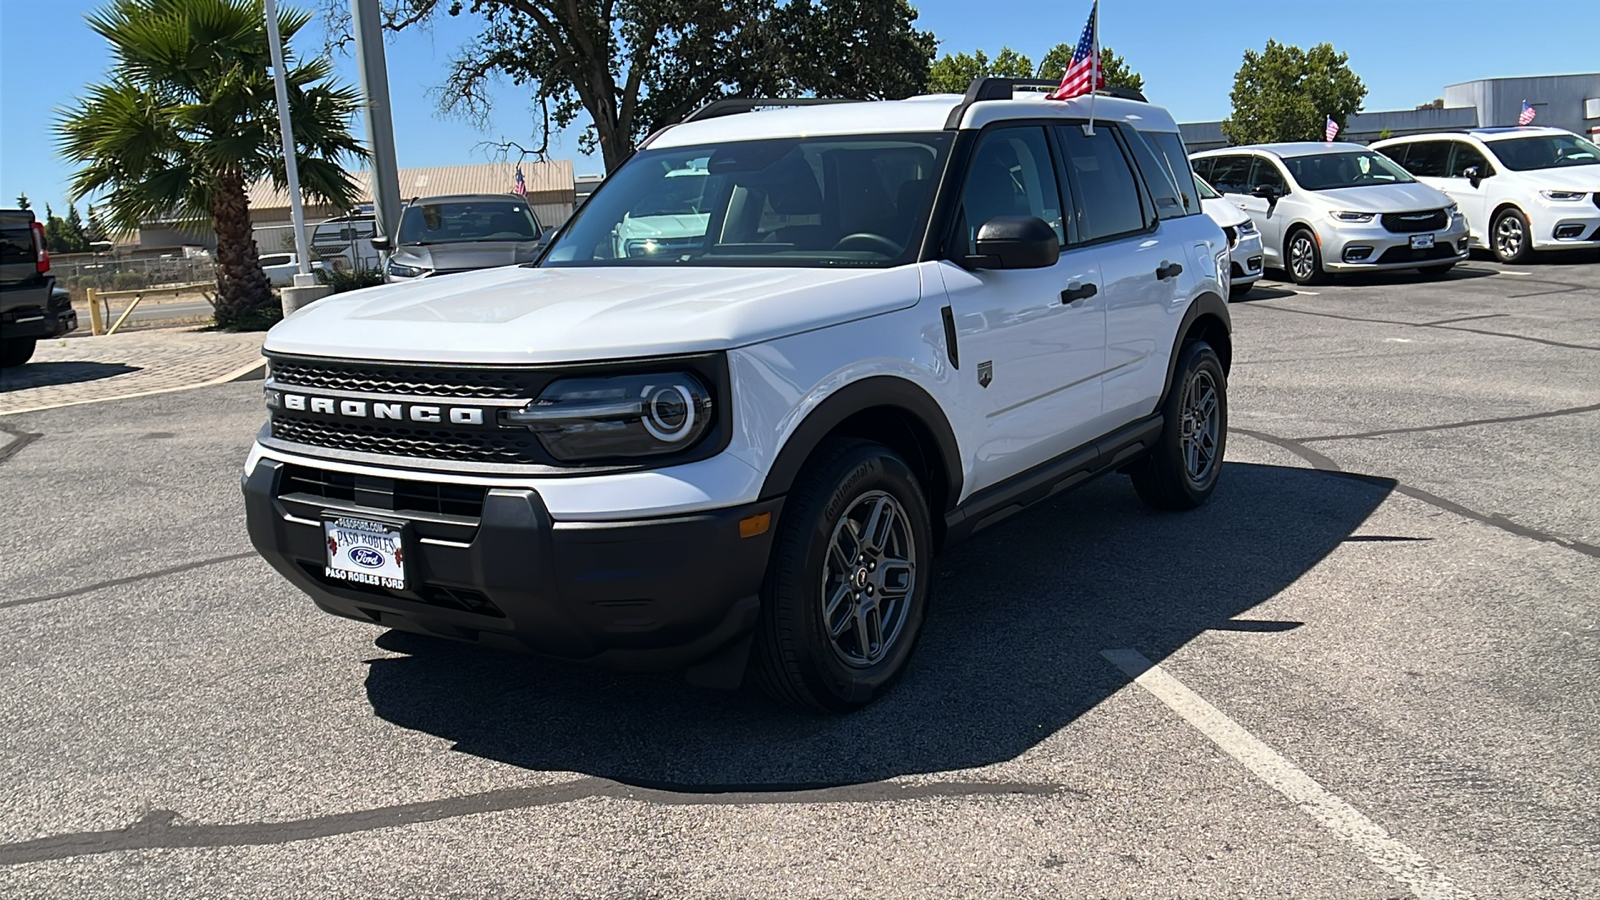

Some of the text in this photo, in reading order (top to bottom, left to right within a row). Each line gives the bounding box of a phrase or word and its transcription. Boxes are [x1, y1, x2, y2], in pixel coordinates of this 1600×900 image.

[284, 394, 483, 424] BRONCO
[337, 531, 396, 555] PASO ROBLES
[355, 550, 379, 565] Ford
[325, 567, 404, 590] PASO ROBLES FORD
